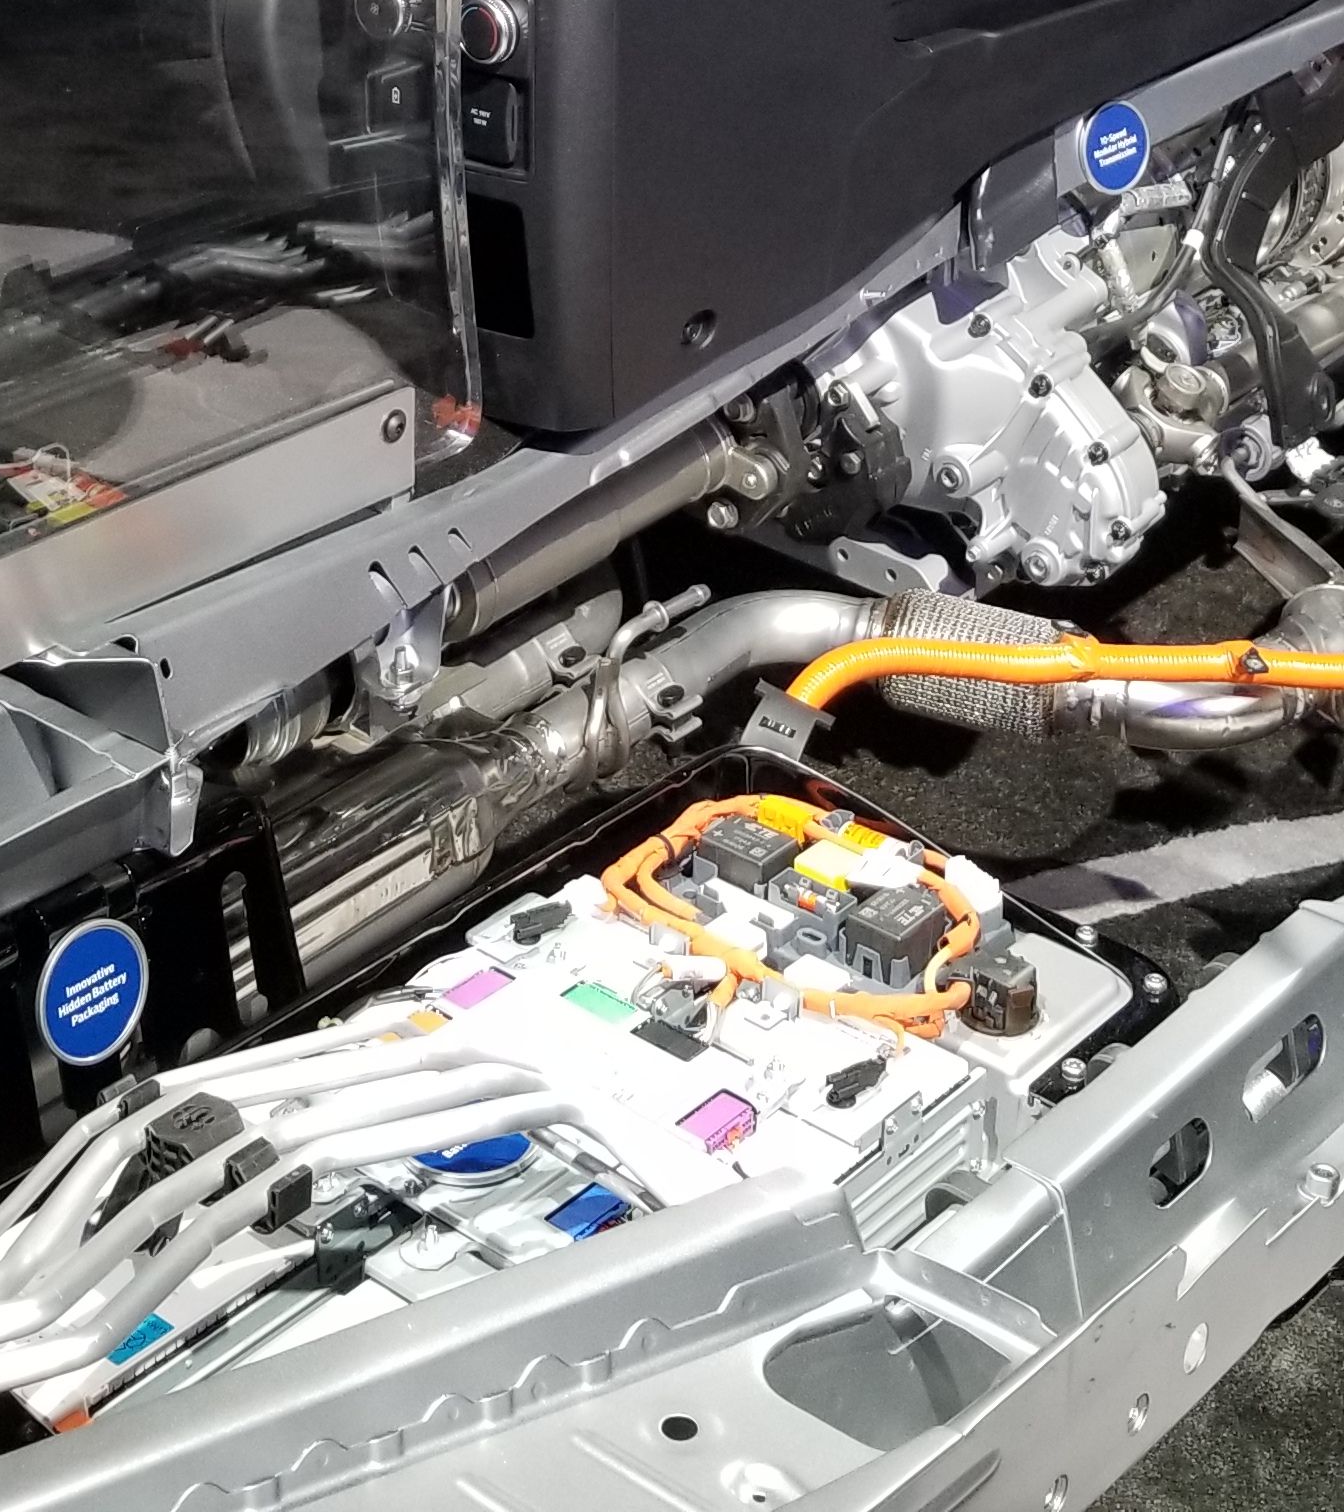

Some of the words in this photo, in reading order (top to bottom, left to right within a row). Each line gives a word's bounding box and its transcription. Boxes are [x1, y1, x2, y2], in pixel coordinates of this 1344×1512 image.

[58, 992, 93, 1019] Hidden
[91, 971, 128, 999] Battery
[65, 963, 116, 999] Innovative
[71, 992, 120, 1028] Packaging
